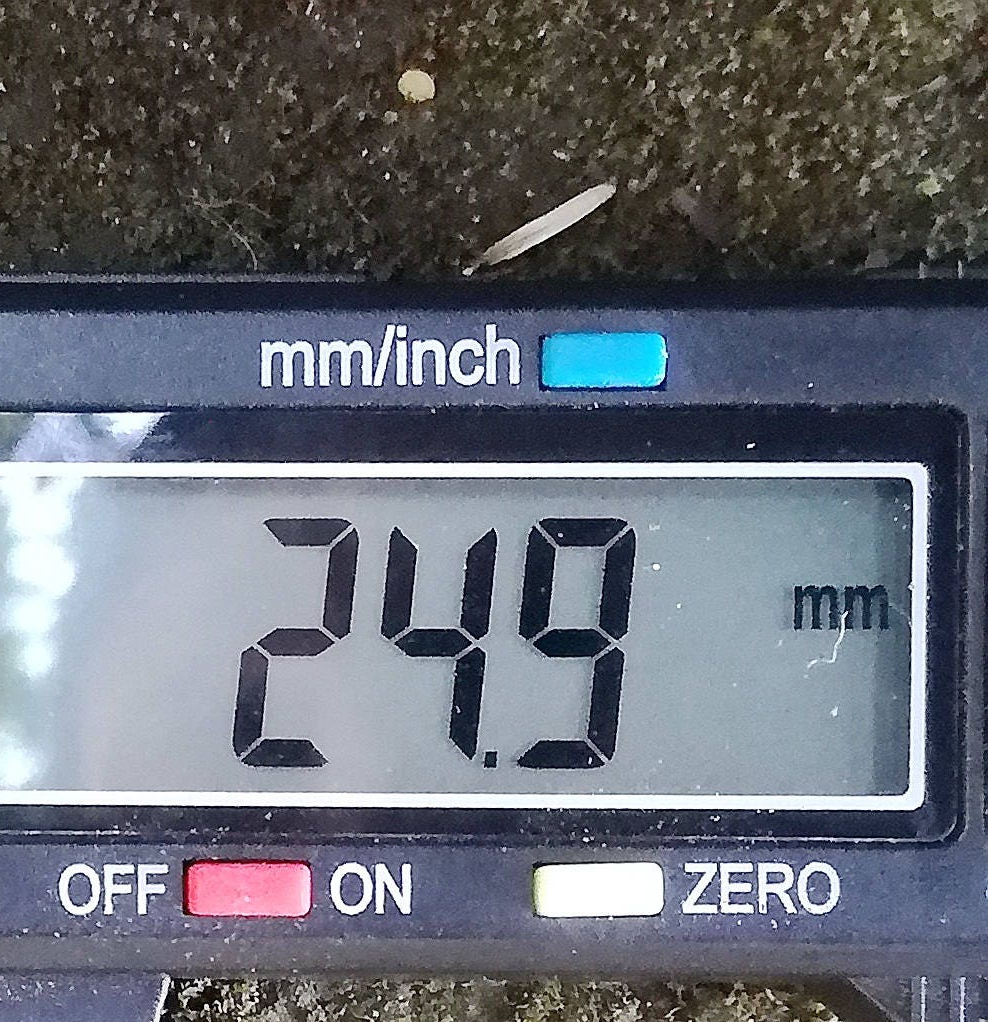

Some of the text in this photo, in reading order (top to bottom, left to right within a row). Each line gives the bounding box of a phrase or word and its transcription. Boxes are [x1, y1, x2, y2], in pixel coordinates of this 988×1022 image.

[260, 323, 521, 388] mm/inch
[232, 517, 891, 770] 24.9 mm
[58, 861, 842, 917] OFF ON ZERO
